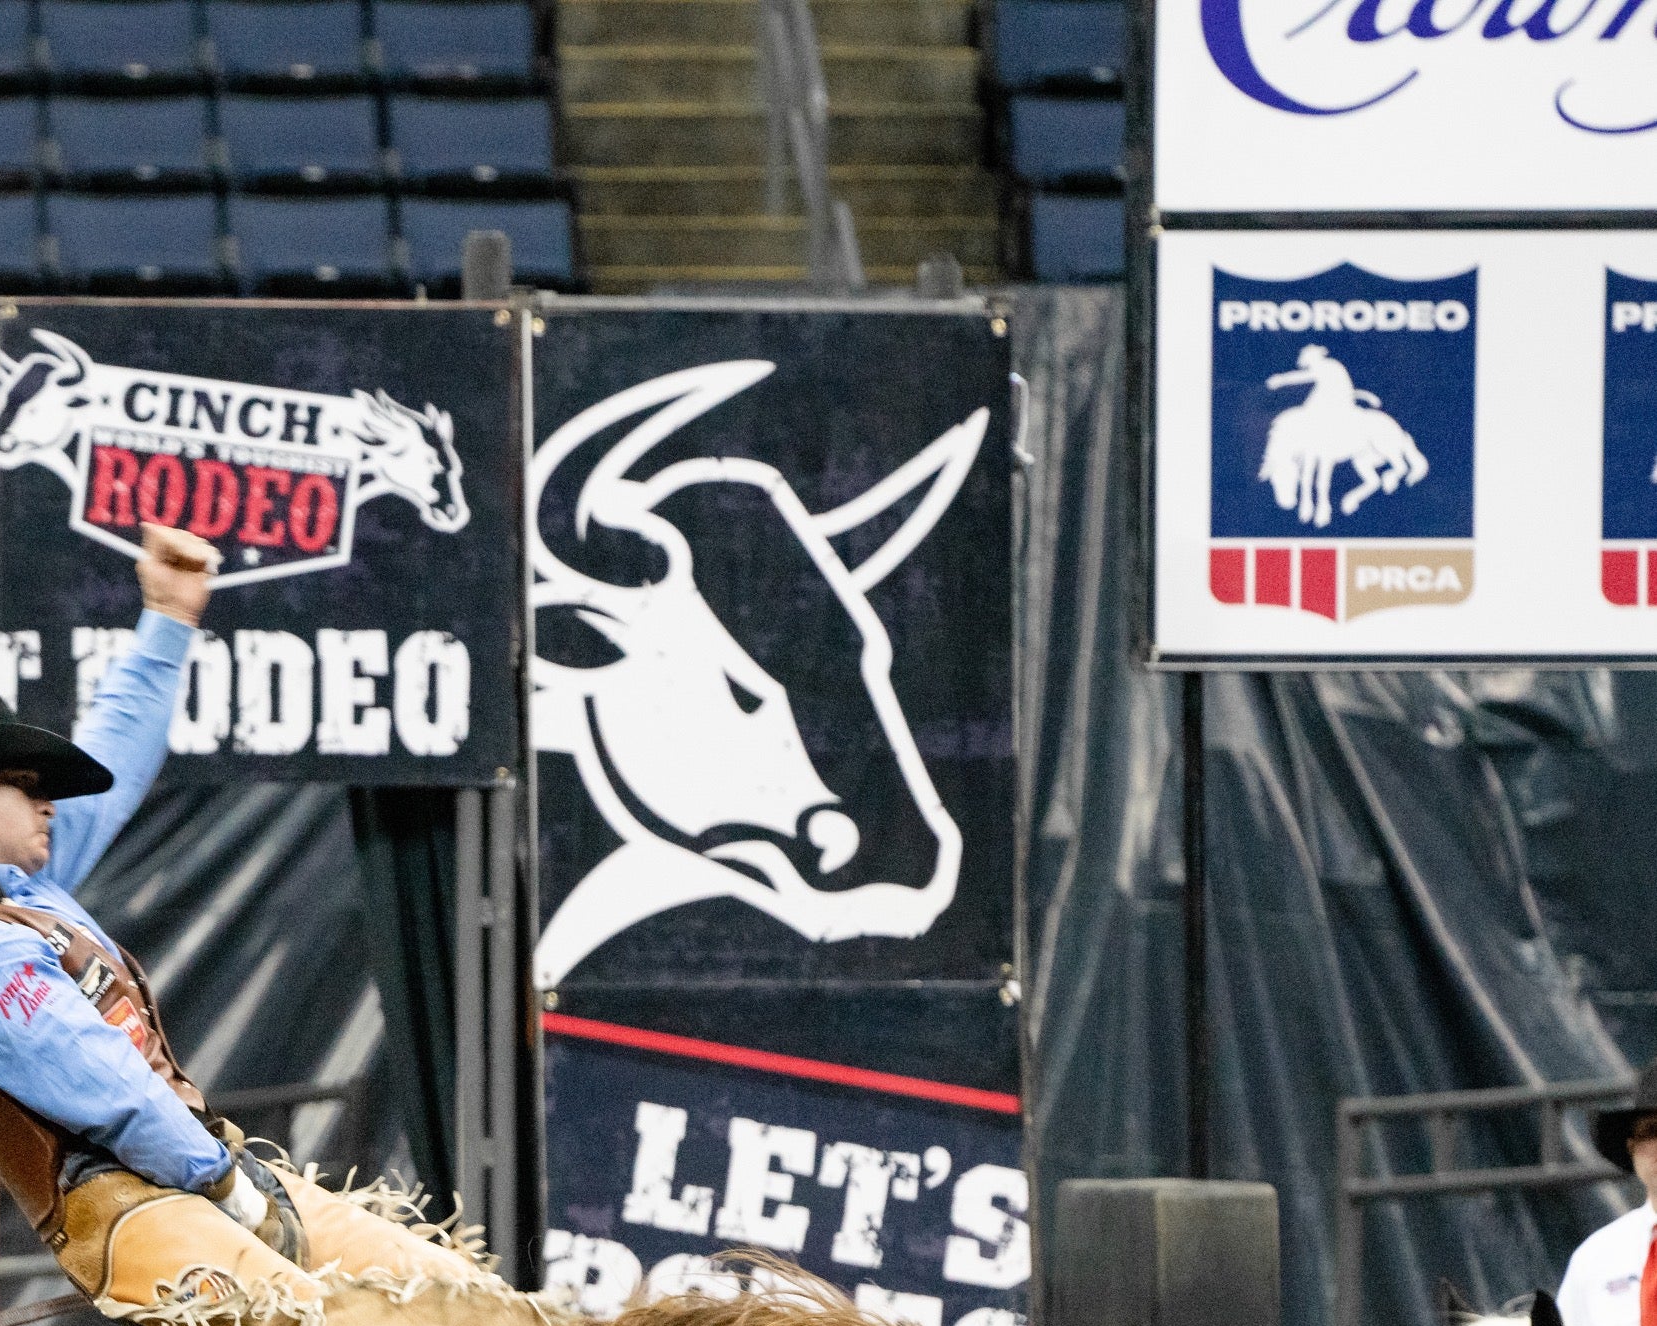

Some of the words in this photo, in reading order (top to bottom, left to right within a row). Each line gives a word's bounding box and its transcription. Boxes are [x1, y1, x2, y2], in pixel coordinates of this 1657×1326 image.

[1218, 300, 1470, 333] PRORODEO
[123, 383, 324, 445] CINCH
[85, 445, 339, 553] RODEO
[1355, 566, 1463, 592] PRCA
[622, 1101, 1032, 1289] LET'S
